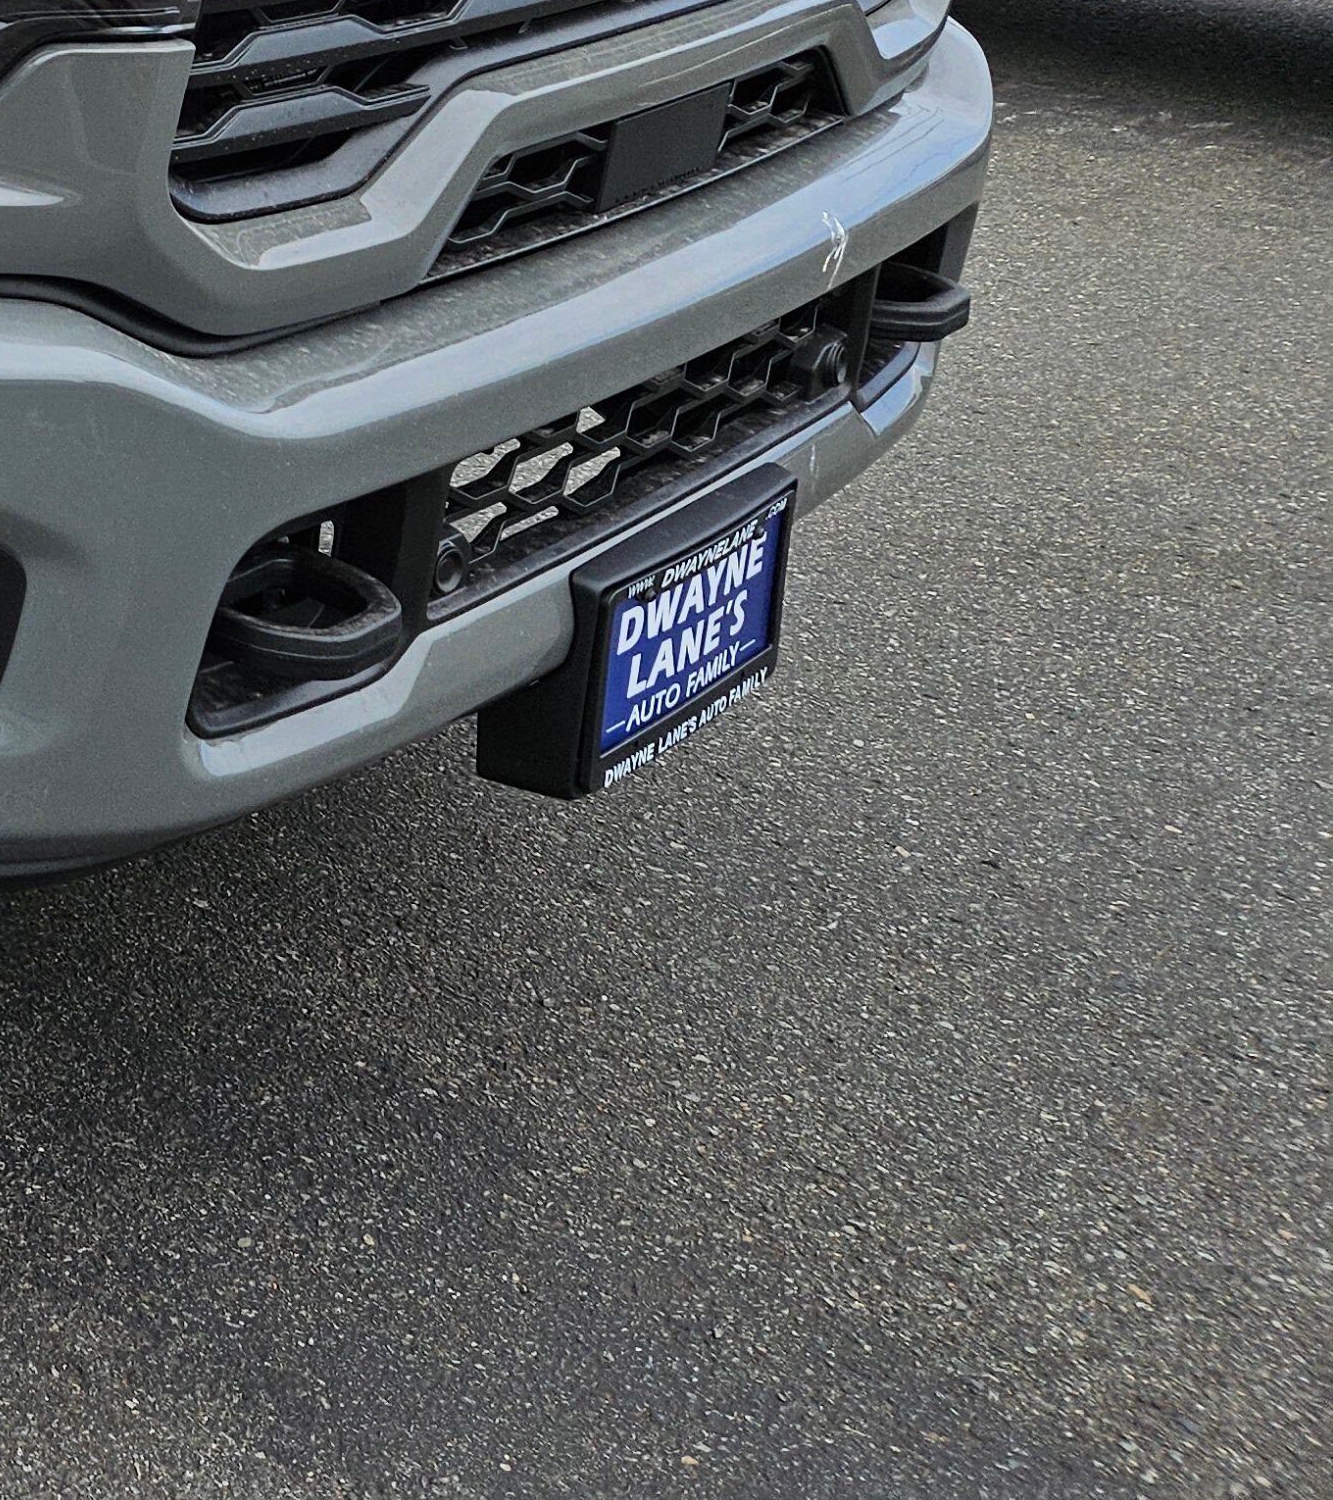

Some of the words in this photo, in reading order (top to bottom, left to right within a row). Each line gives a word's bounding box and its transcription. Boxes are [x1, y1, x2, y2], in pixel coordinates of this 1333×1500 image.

[617, 531, 768, 656] DWAYNE
[626, 589, 748, 699] LANE'S
[604, 742, 656, 789] DWAYNE
[658, 715, 698, 755] LANE'S
[698, 696, 727, 728] AUTO
[728, 666, 769, 707] FAMILY
[625, 682, 681, 733] AUTO
[685, 641, 741, 698] FAMILY
